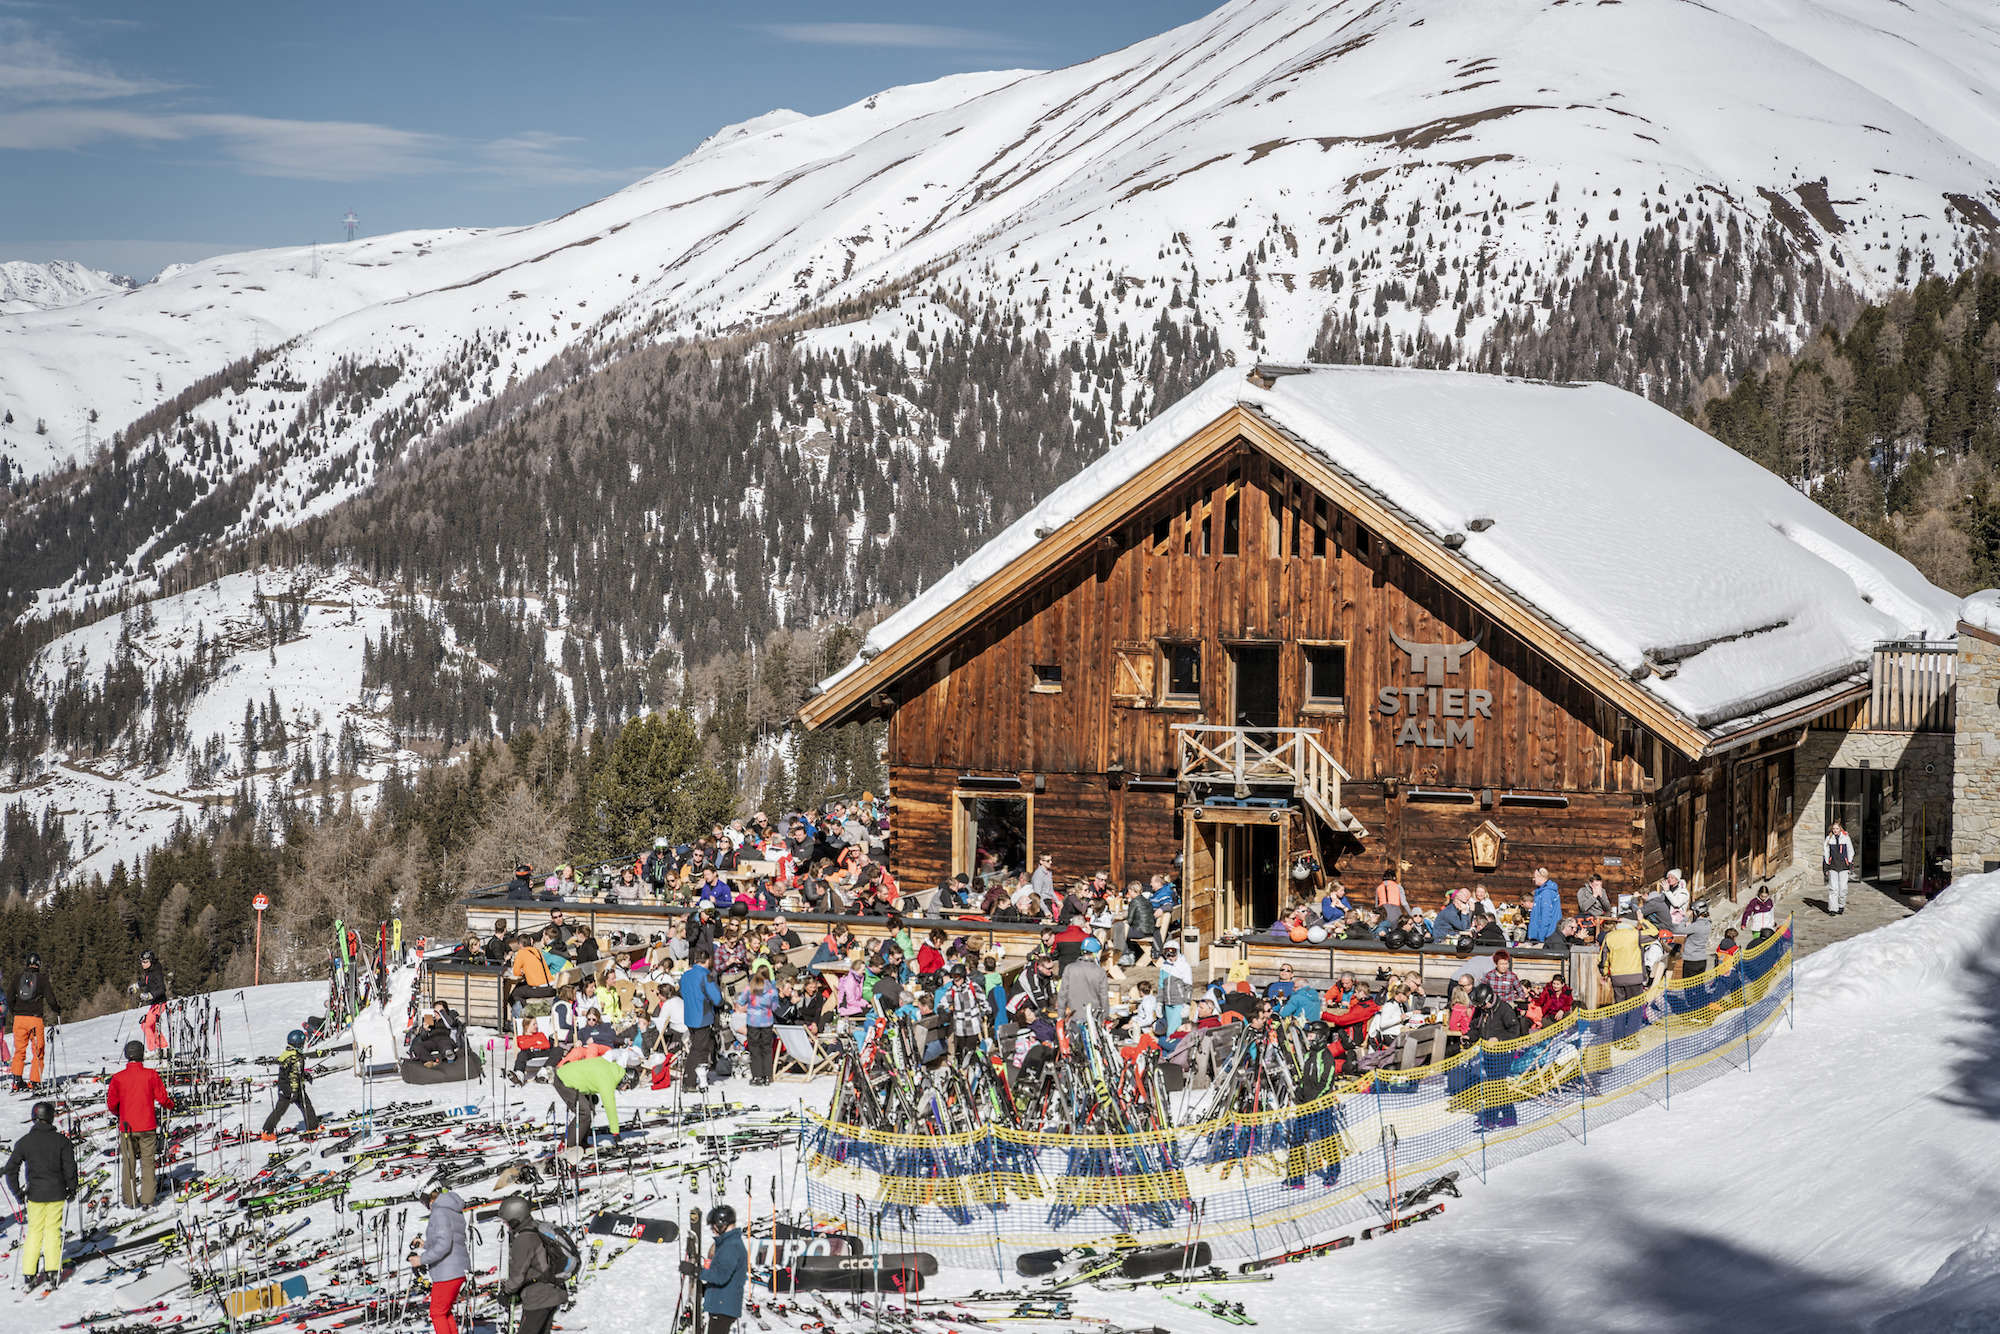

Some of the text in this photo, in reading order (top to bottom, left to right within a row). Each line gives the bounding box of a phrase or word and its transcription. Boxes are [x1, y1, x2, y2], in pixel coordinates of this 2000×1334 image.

[1378, 686, 1493, 718] STIER
[1396, 718, 1475, 748] ALM
[255, 897, 266, 905] 27
[612, 1220, 635, 1237] head
